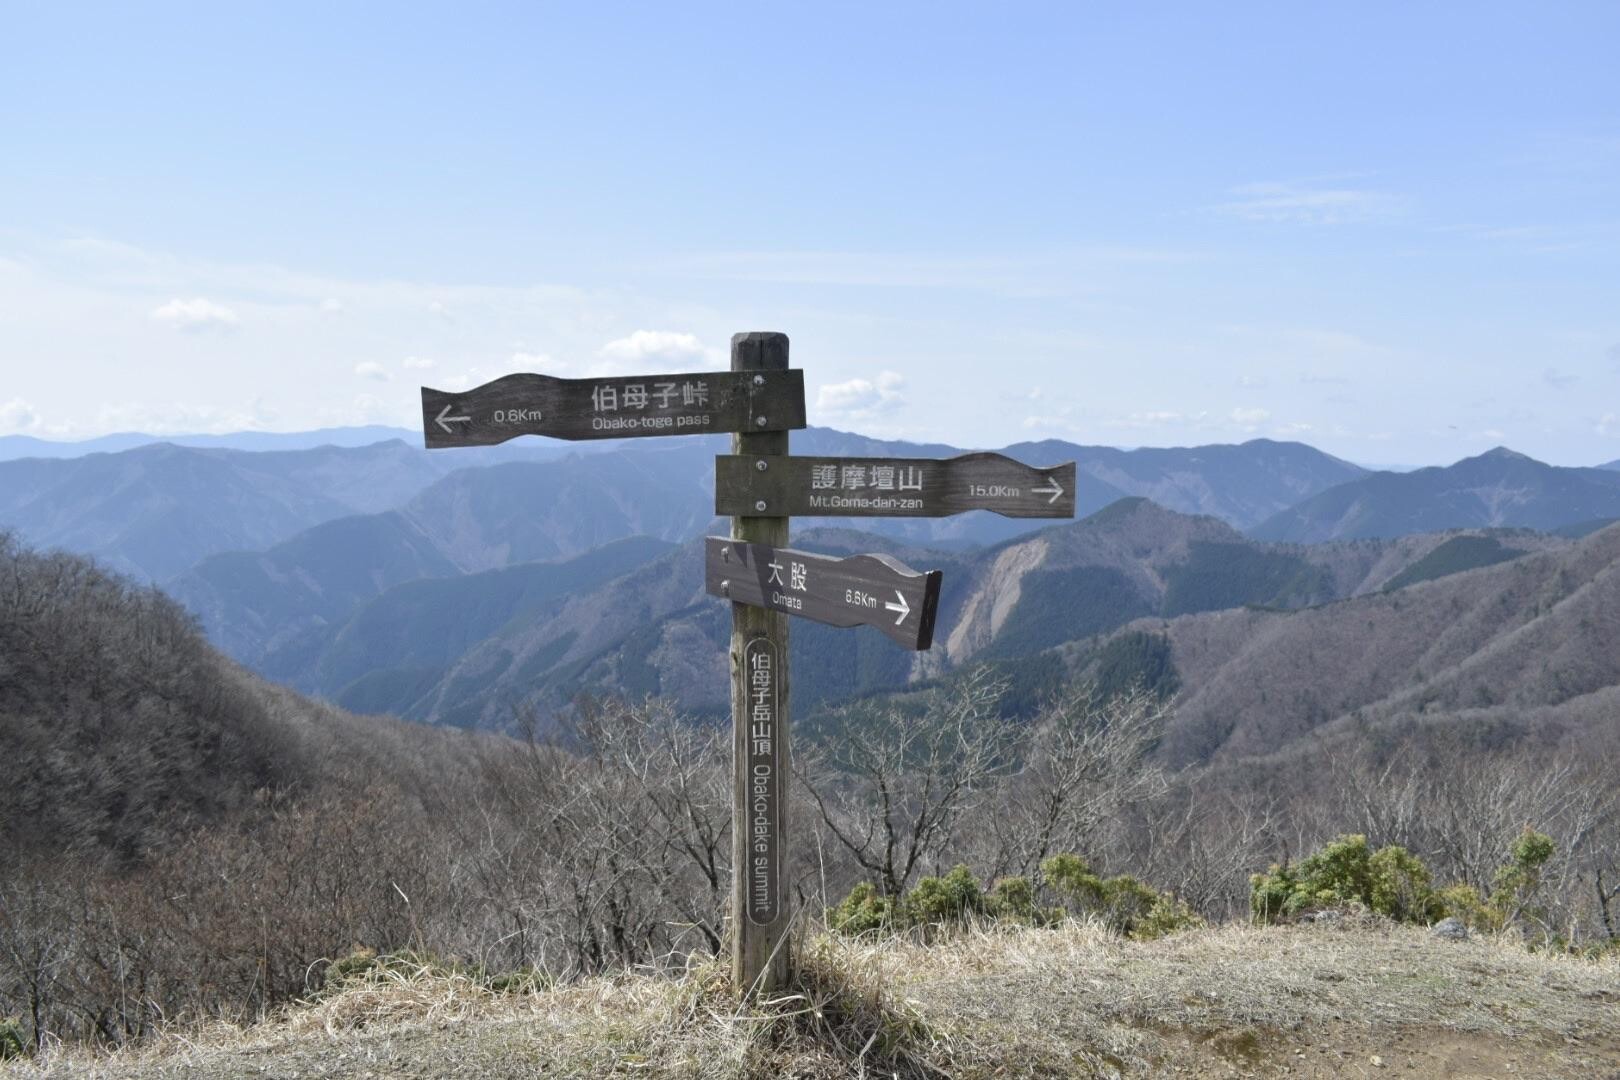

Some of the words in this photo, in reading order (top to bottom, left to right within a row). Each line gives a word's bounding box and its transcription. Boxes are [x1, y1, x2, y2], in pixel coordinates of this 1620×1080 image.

[591, 381, 709, 412] 伯母子峠
[494, 409, 542, 424] 0.6Km
[592, 415, 672, 430] Obako-toge
[676, 414, 710, 428] pass
[811, 464, 923, 491] 護摩壇山
[969, 484, 1020, 498] 15.0Km
[768, 560, 807, 592] 大股
[772, 591, 802, 610] Omata
[845, 588, 877, 609] 6.6Km
[751, 652, 772, 756] 伯母子岳山頂
[753, 764, 772, 853] Obako-dake
[754, 858, 772, 913] summit
